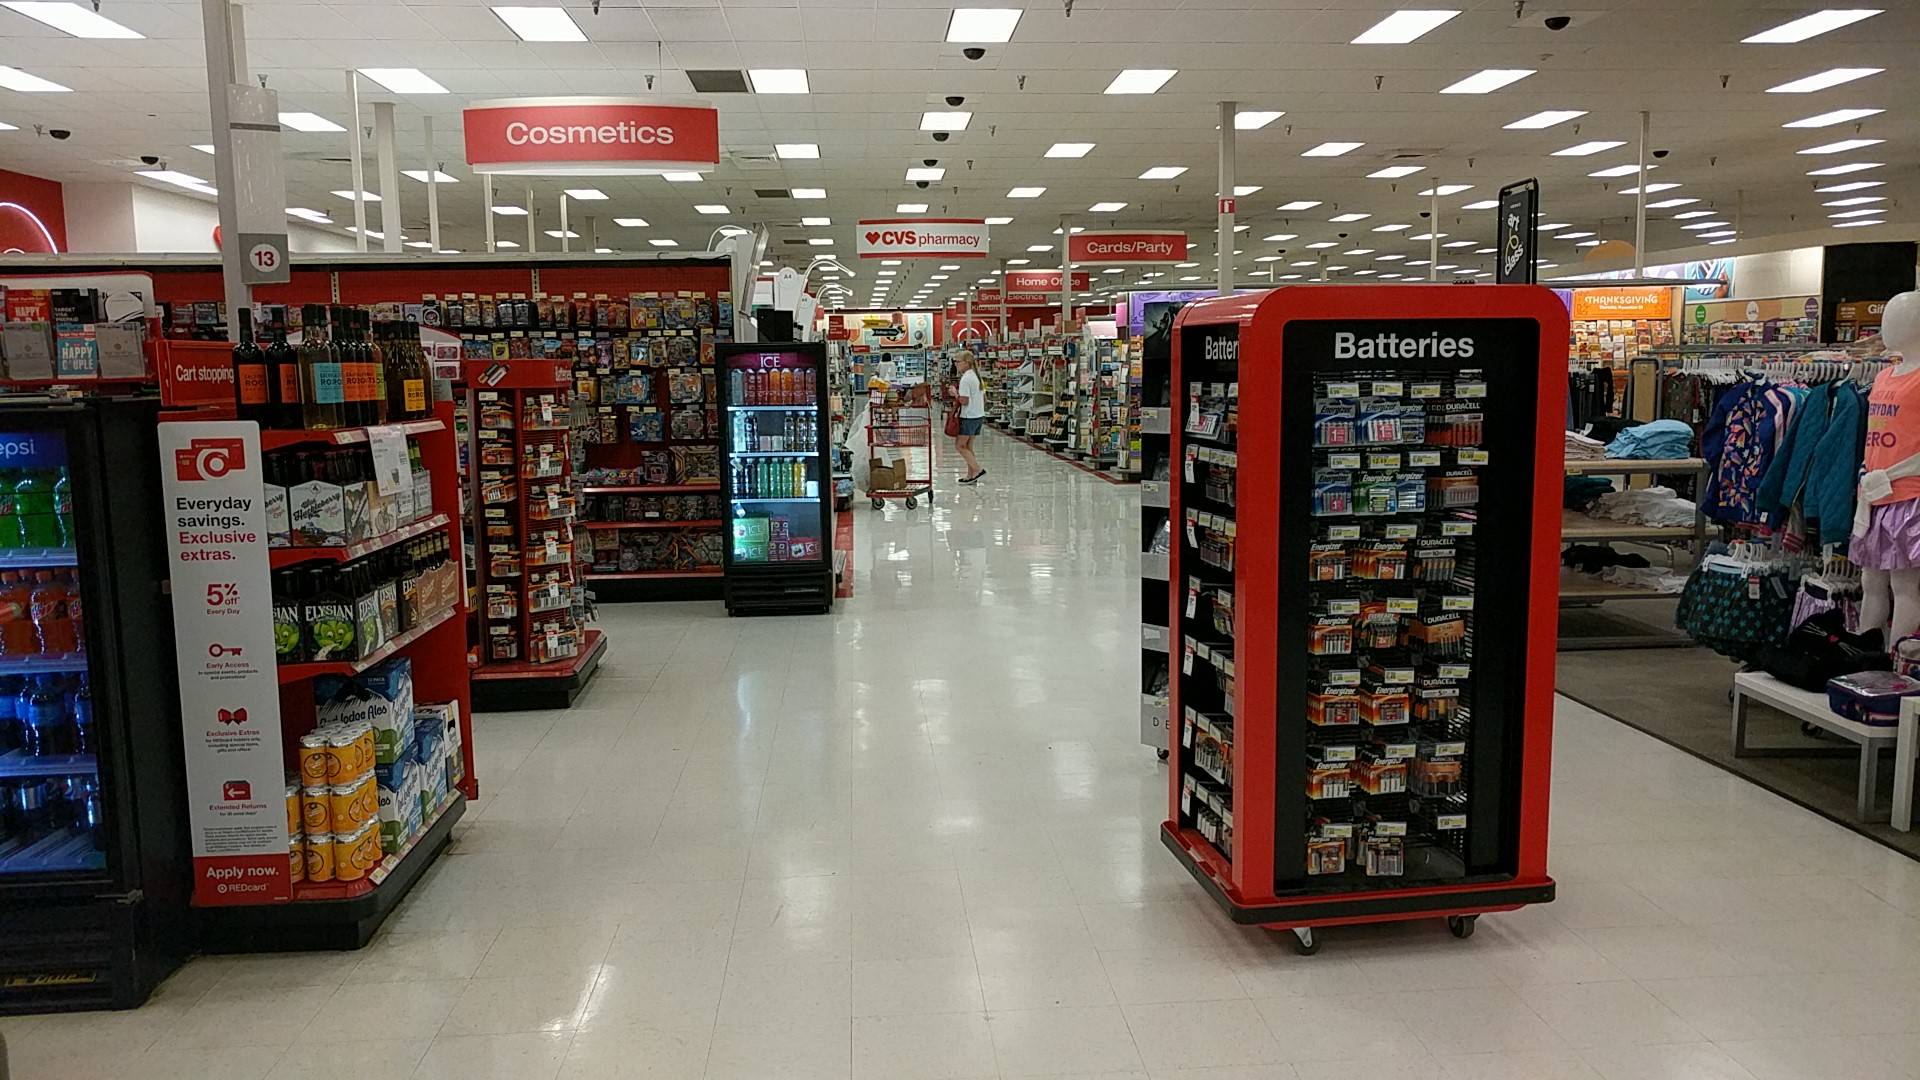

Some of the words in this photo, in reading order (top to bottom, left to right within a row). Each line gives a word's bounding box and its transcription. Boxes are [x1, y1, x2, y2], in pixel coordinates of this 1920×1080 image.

[505, 121, 674, 147] Cosmetics
[1508, 213, 1520, 232] art
[881, 230, 917, 246] CVS
[918, 232, 981, 248] pharmacy
[1086, 241, 1174, 256] Cards/Party
[254, 250, 276, 267] 13
[1504, 245, 1524, 276] class
[1016, 277, 1048, 286] Home
[1050, 276, 1081, 286] Ofce
[1584, 294, 1658, 305] THANKSGIVING
[15, 306, 40, 317] HAPPY
[1868, 304, 1885, 314] Gif
[1205, 335, 1240, 360] Batter
[1334, 331, 1475, 359] Batteries
[62, 347, 93, 360] HAPPY
[760, 356, 781, 368] ICE
[175, 364, 197, 382] Cart
[198, 364, 234, 384] stopping
[1320, 404, 1352, 414] Energizer
[1365, 402, 1397, 412] Energizer
[1399, 404, 1424, 412] nergizer
[1446, 402, 1481, 412] DURACELL
[1870, 403, 1900, 416] ERYDAY
[1331, 430, 1338, 441] 1
[1380, 426, 1386, 438] 1
[1866, 431, 1896, 448] ERO
[1318, 474, 1350, 483] Energizer
[1362, 474, 1394, 483] Energizer
[1396, 472, 1424, 480] nergizer
[176, 496, 252, 512] Everyday
[177, 514, 246, 530] savings.
[748, 525, 762, 534] ICE
[179, 530, 256, 544] Exclusive
[1421, 538, 1454, 547] DURACELL
[750, 546, 763, 556] ICE
[806, 542, 820, 552] ICE
[1311, 542, 1342, 552] Energizer
[1374, 542, 1404, 552] Energizer
[180, 548, 236, 561] extras.
[206, 583, 238, 606] 5%
[304, 604, 354, 622] ELYSIAN
[1427, 612, 1461, 624] DURACELL
[1318, 617, 1350, 626] Energizer
[1423, 678, 1457, 686] DURACELL
[1324, 687, 1356, 696] Energizer
[1375, 686, 1406, 696] Energizer
[368, 705, 388, 719] Ales
[1153, 716, 1160, 727] D
[1317, 762, 1347, 770] Energizer
[206, 866, 244, 880] Apply
[248, 866, 280, 876] now.
[229, 884, 267, 892] REDcard
